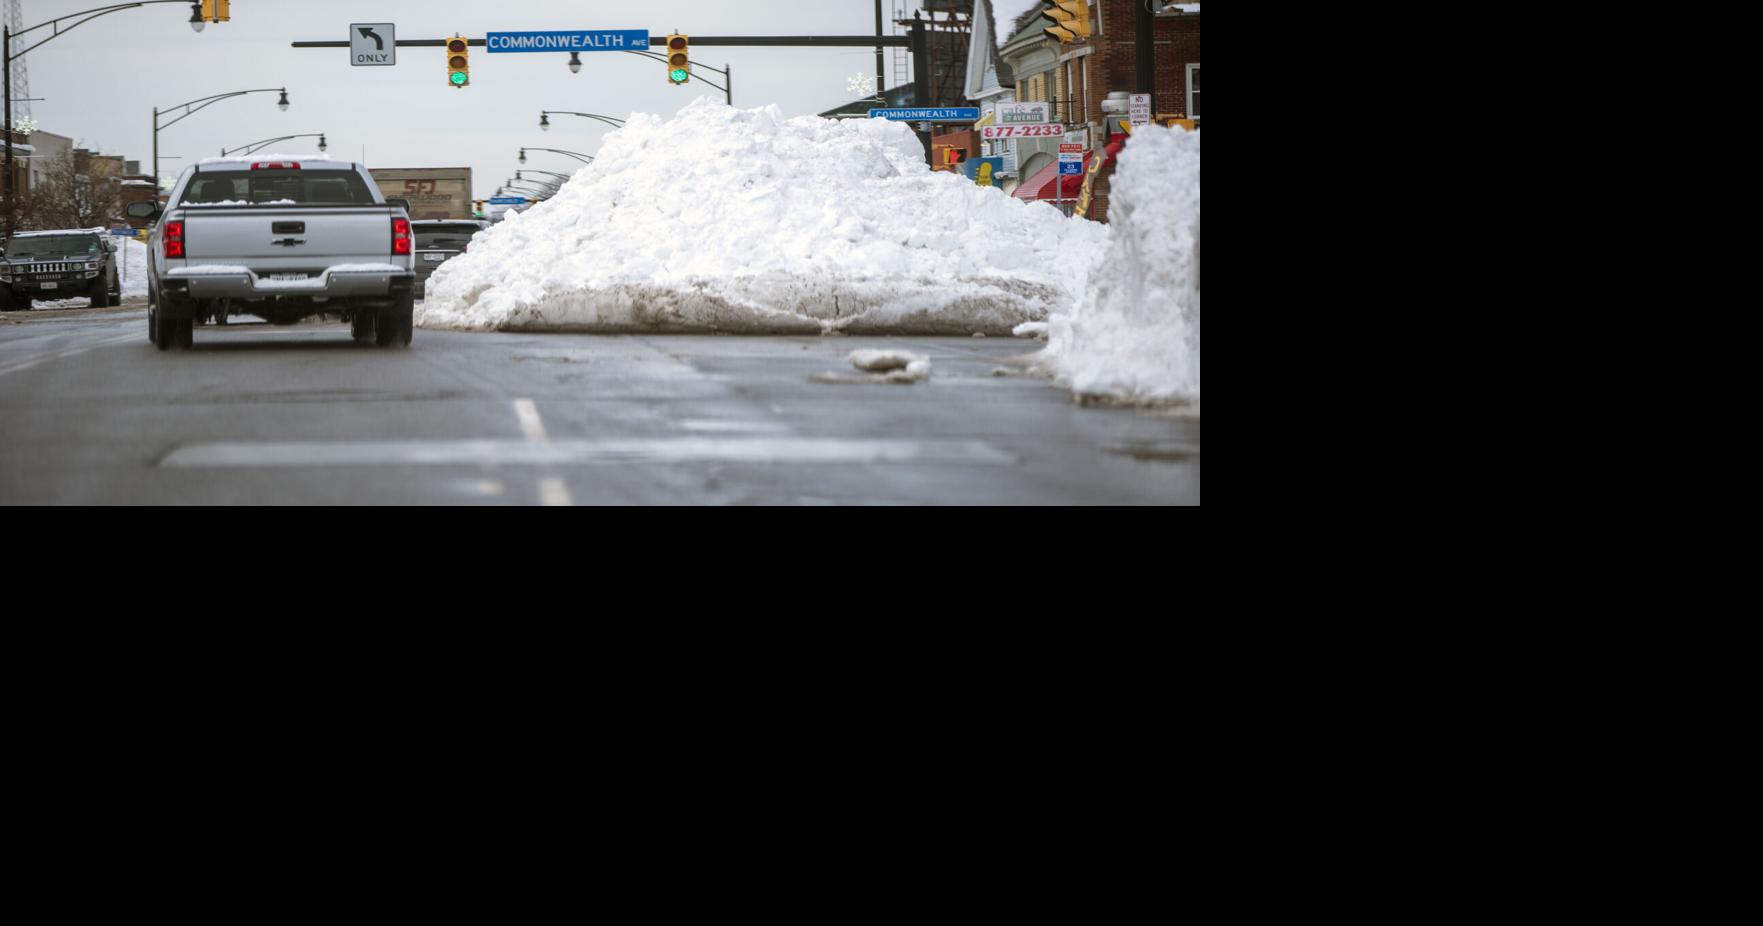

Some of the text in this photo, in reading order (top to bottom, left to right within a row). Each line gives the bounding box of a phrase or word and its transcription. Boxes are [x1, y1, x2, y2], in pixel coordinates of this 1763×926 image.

[488, 34, 624, 49] COMMONWEALTH
[357, 54, 388, 63] ONLY
[1135, 95, 1144, 103] NO
[876, 110, 958, 118] COMMONWEALTH
[984, 125, 1062, 138] 877-2233
